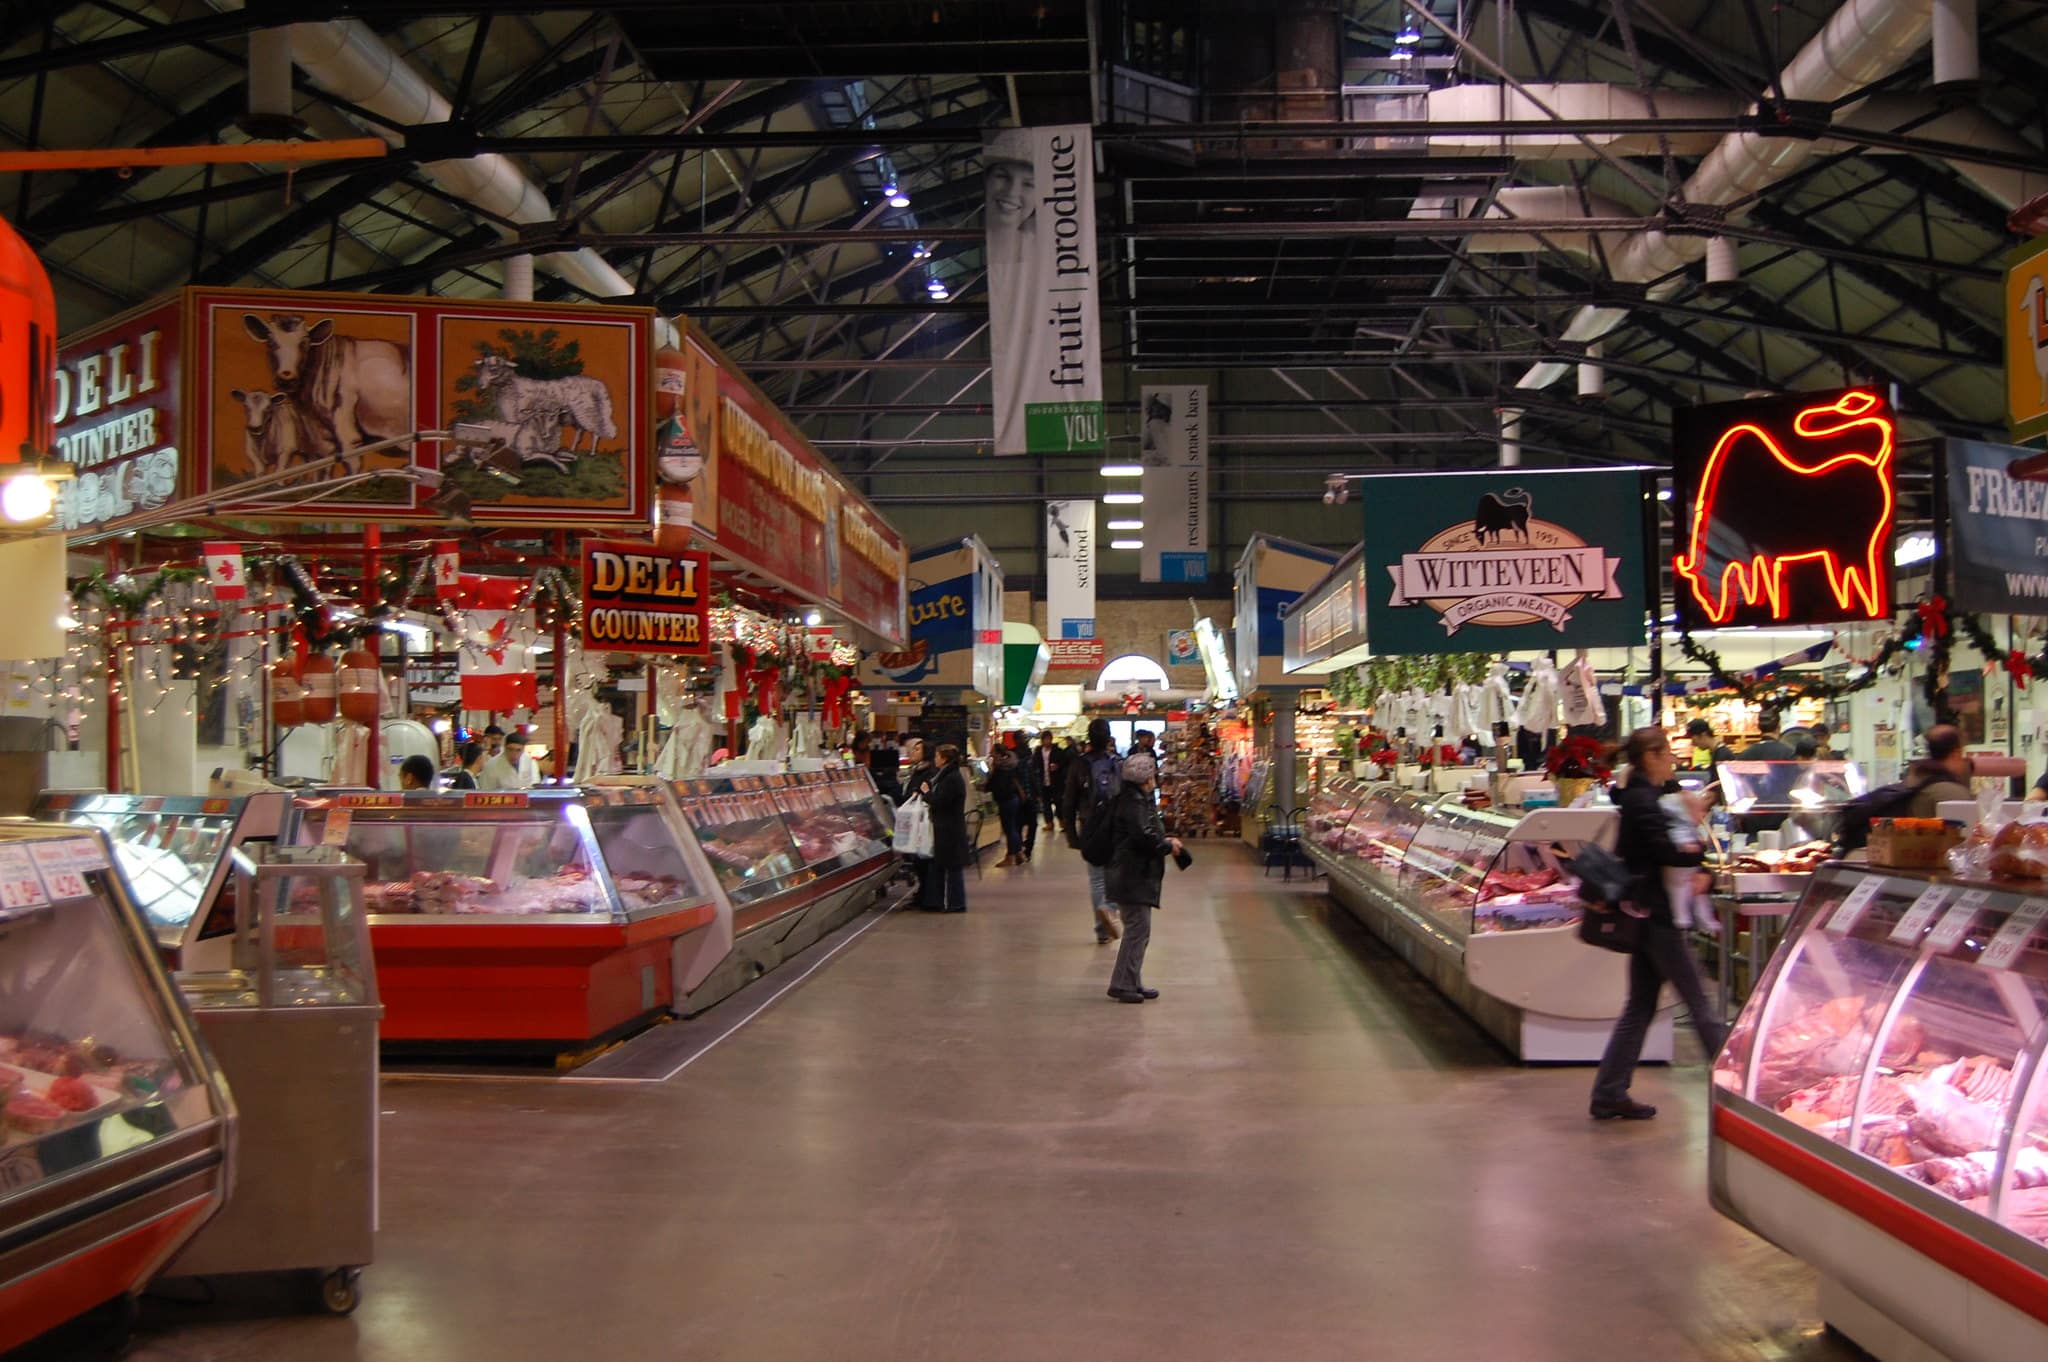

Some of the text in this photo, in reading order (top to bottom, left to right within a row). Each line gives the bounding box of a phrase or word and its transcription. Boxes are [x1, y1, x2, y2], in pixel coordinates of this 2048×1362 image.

[1043, 135, 1090, 278] produce
[1049, 302, 1084, 388] fruit
[56, 406, 157, 469] OUNTER
[1185, 389, 1201, 547] restaurants snack bars
[1074, 530, 1089, 589] seafood
[1442, 529, 1559, 551] SINCE 1951
[592, 551, 698, 598] DELI
[1415, 553, 1585, 592] WITTEVEEN
[590, 608, 700, 643] COUNTER
[1457, 595, 1559, 618] ORGANIC MEATS
[1049, 644, 1103, 655] EESE
